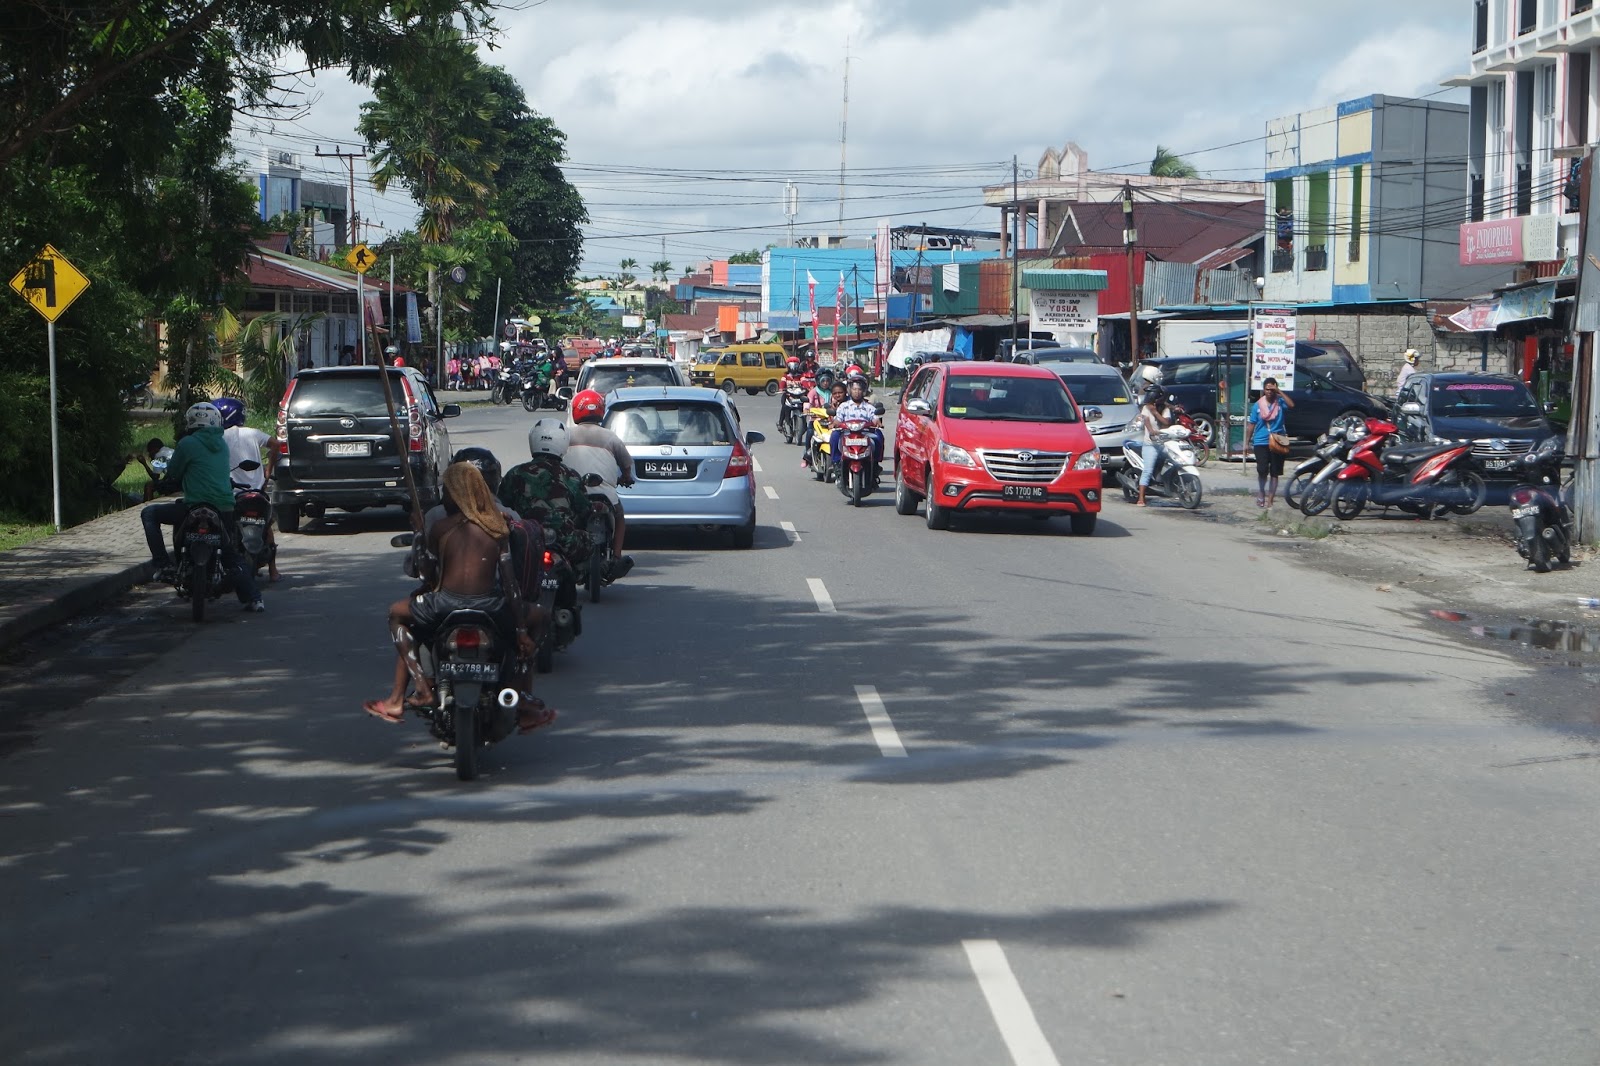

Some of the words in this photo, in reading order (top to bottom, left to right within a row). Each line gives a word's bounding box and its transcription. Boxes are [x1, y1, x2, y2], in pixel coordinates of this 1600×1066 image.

[1476, 226, 1512, 248] INDOPRIMA
[645, 462, 656, 471] DS
[661, 463, 672, 471] 40
[676, 463, 688, 471] LA
[1004, 486, 1013, 494] DS
[1016, 487, 1031, 496] 1700
